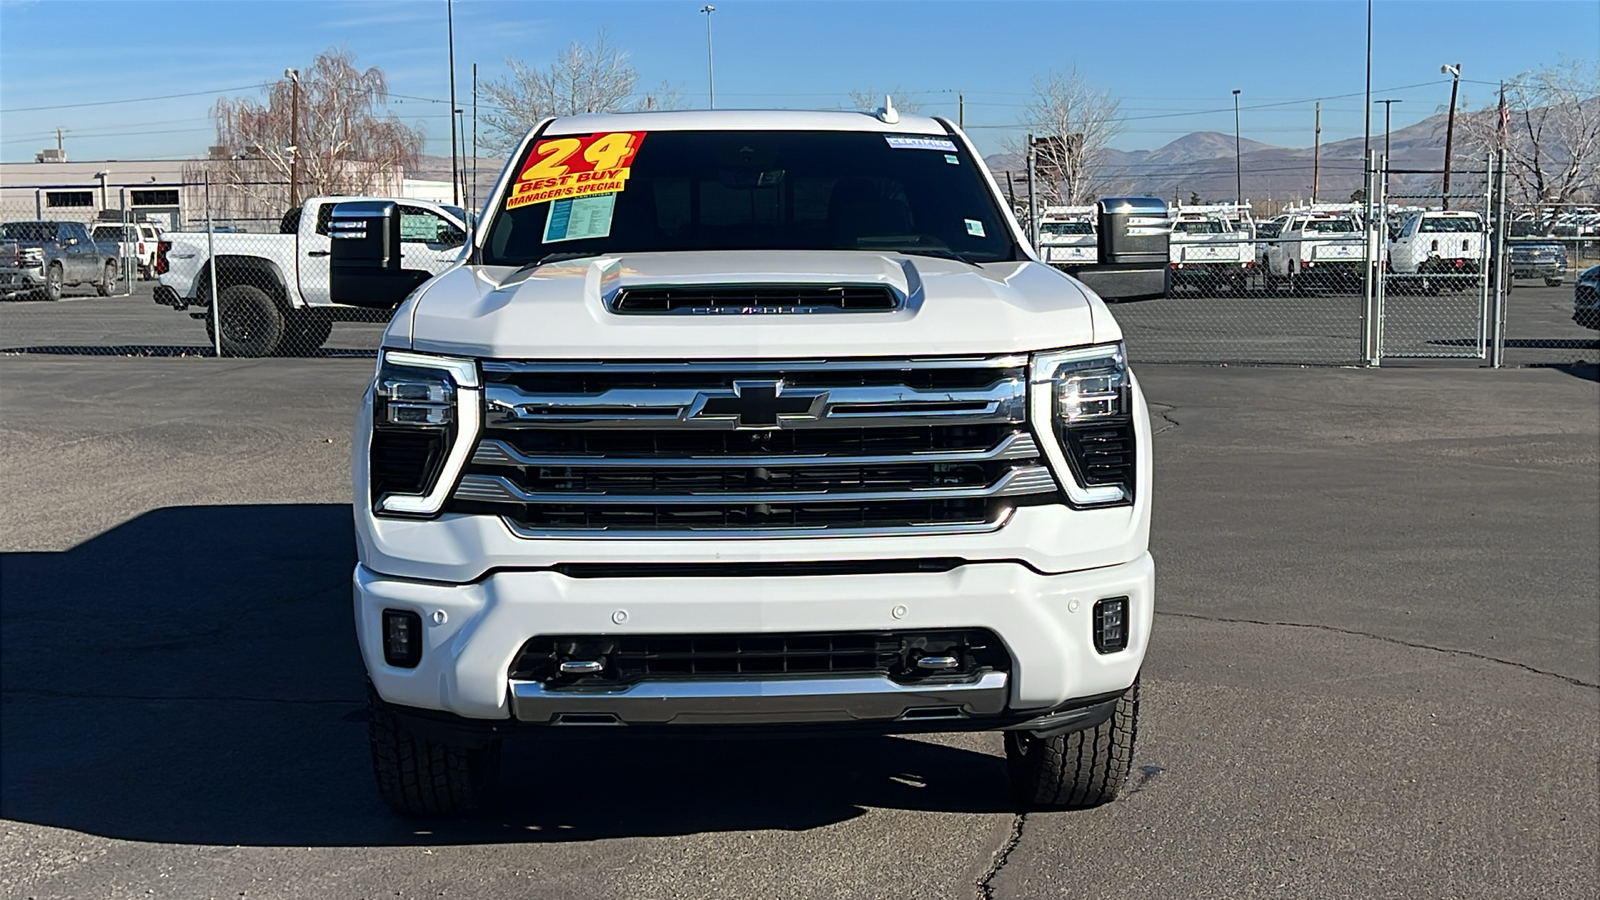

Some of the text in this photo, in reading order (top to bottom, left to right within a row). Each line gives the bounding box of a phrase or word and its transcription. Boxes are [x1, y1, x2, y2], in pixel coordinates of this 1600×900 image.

[889, 138, 951, 147] CERTIFIED
[522, 133, 636, 180] 24
[508, 181, 623, 207] MANAGER'S SPECIAL
[518, 169, 623, 194] BEST BUY
